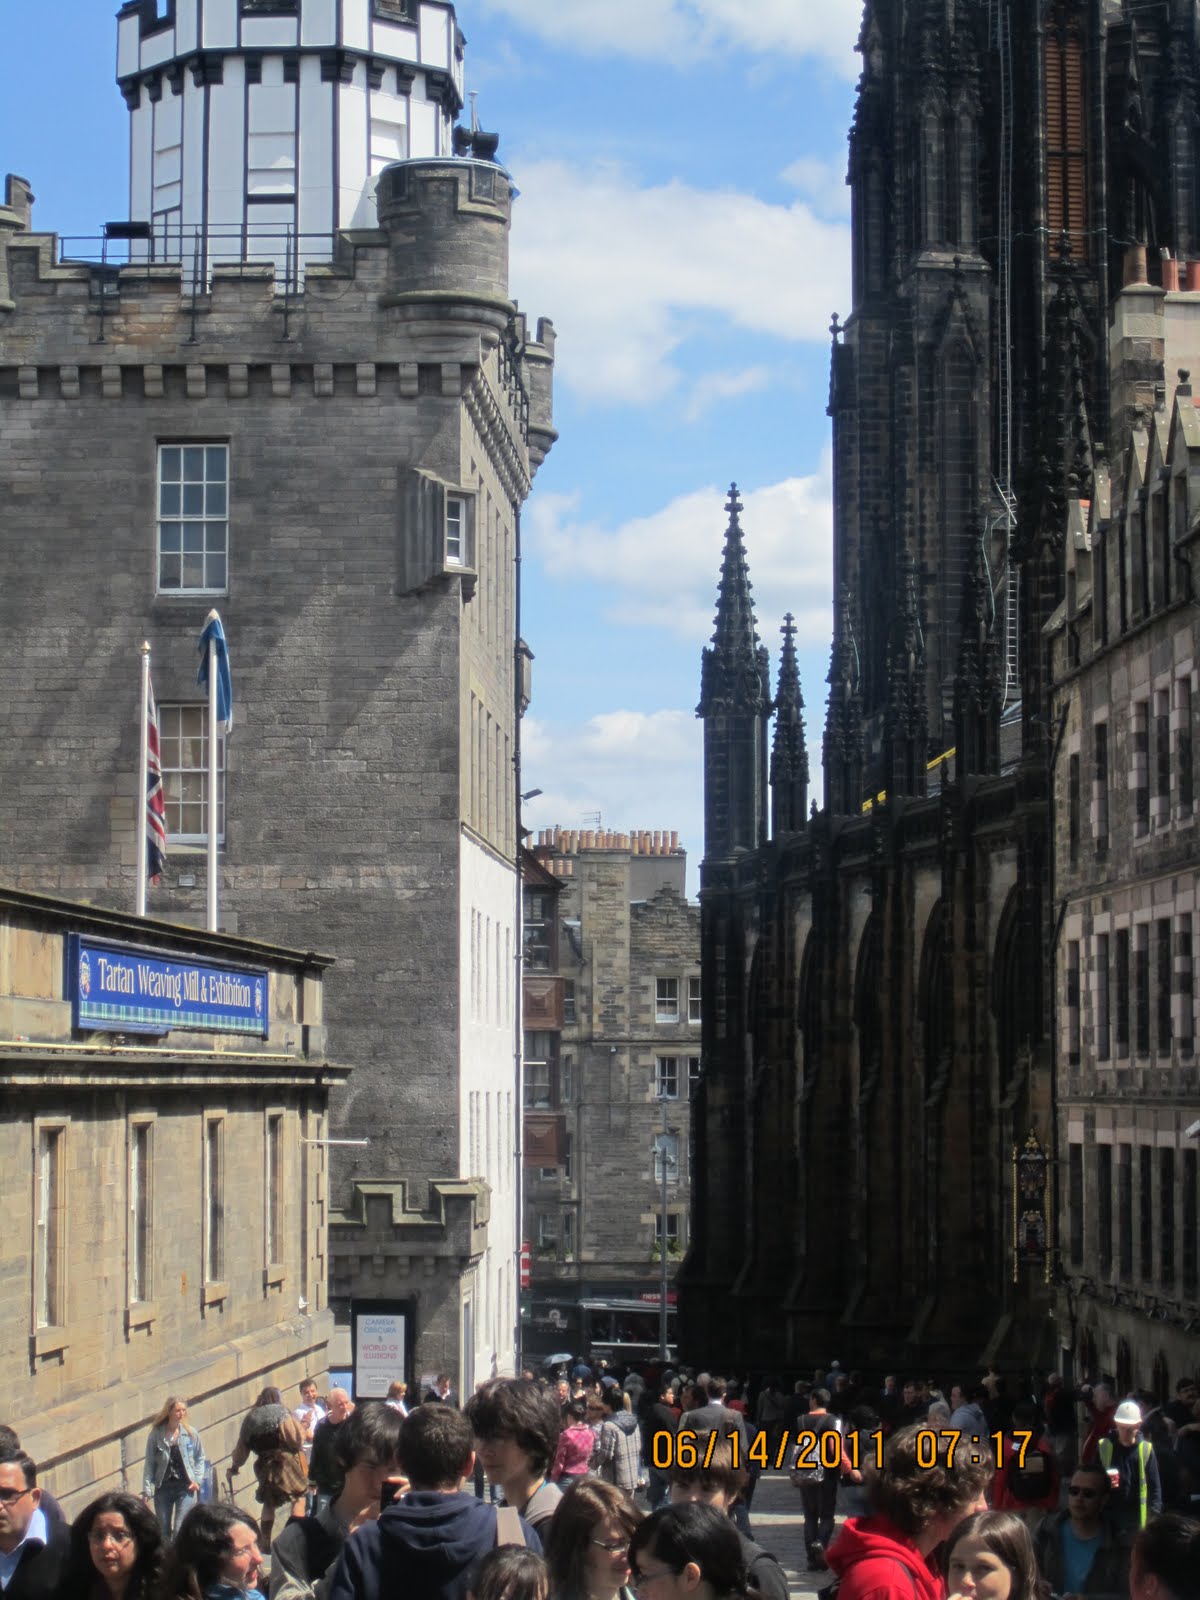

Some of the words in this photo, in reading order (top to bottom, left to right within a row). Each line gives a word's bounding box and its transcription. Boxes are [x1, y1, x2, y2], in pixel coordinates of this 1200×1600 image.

[98, 958, 134, 994] Tartan
[138, 964, 181, 1007] Weaving
[183, 971, 199, 1001] Mill
[201, 976, 207, 1001] &
[209, 975, 251, 1007] Exhibition
